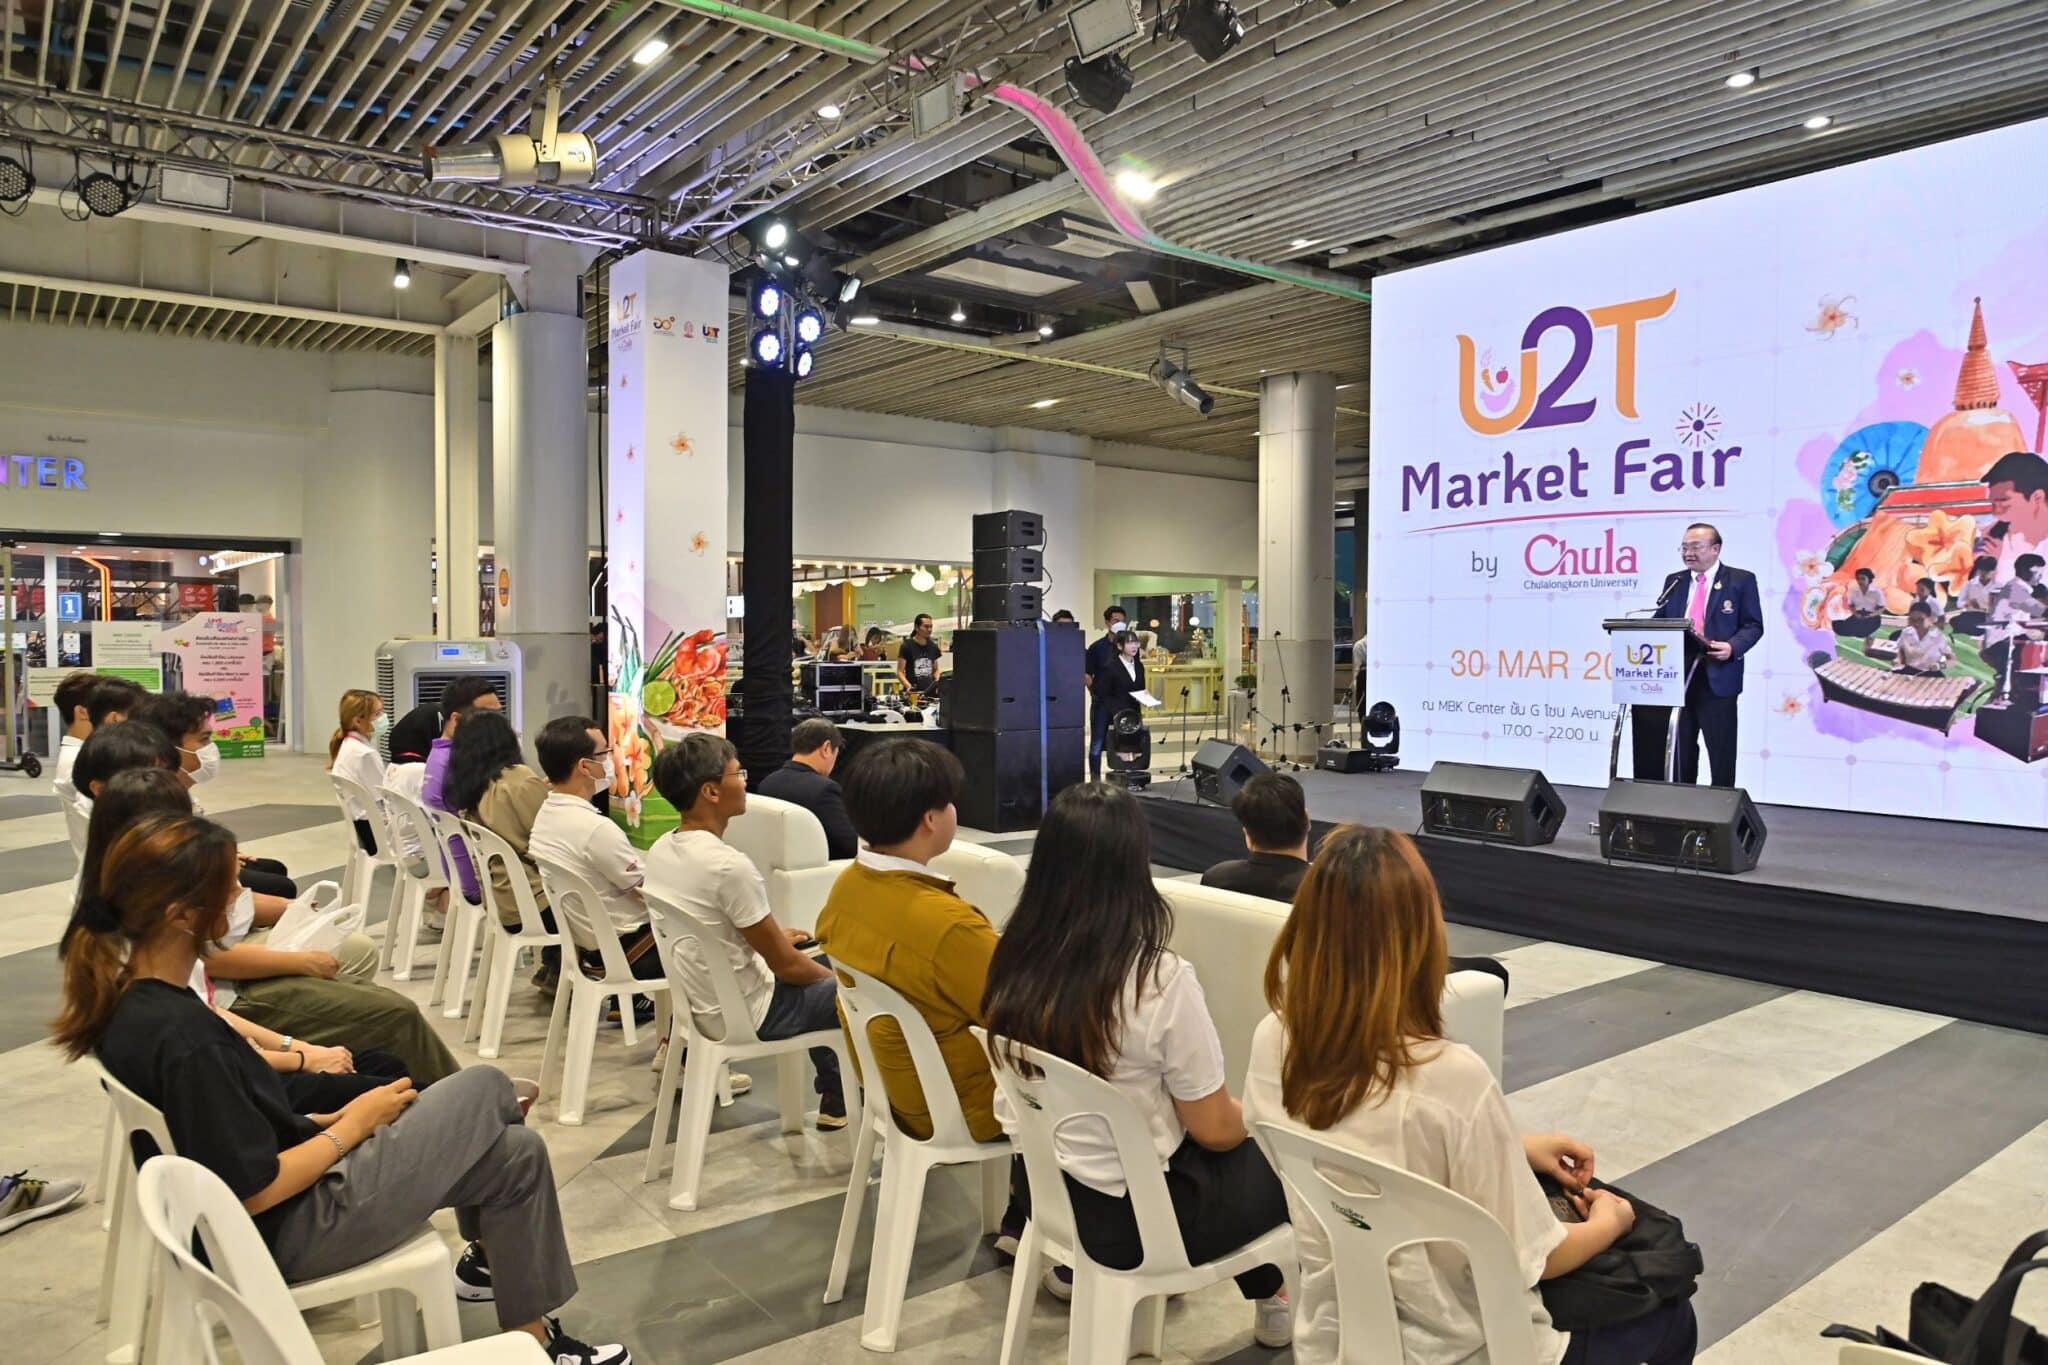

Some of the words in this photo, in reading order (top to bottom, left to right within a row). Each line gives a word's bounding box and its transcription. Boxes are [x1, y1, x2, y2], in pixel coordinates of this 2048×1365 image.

[1455, 288, 1677, 435] U2T
[1401, 447, 1589, 512] Market
[1614, 436, 1742, 495] Fair
[1471, 550, 1498, 578] by
[1524, 528, 1638, 576] Chula
[1523, 579, 1589, 591] Chulalongkorn
[1590, 578, 1638, 589] University
[64, 598, 76, 614] 1
[1450, 649, 1485, 678] 30
[1498, 649, 1569, 680] MAR
[1627, 644, 1667, 666] U2T
[1615, 667, 1653, 678] Market
[1657, 667, 1678, 679] Fair
[1438, 700, 1463, 712] MBK
[1467, 701, 1505, 715] Center
[1530, 704, 1540, 717] G
[1570, 706, 1619, 720] Avenue
